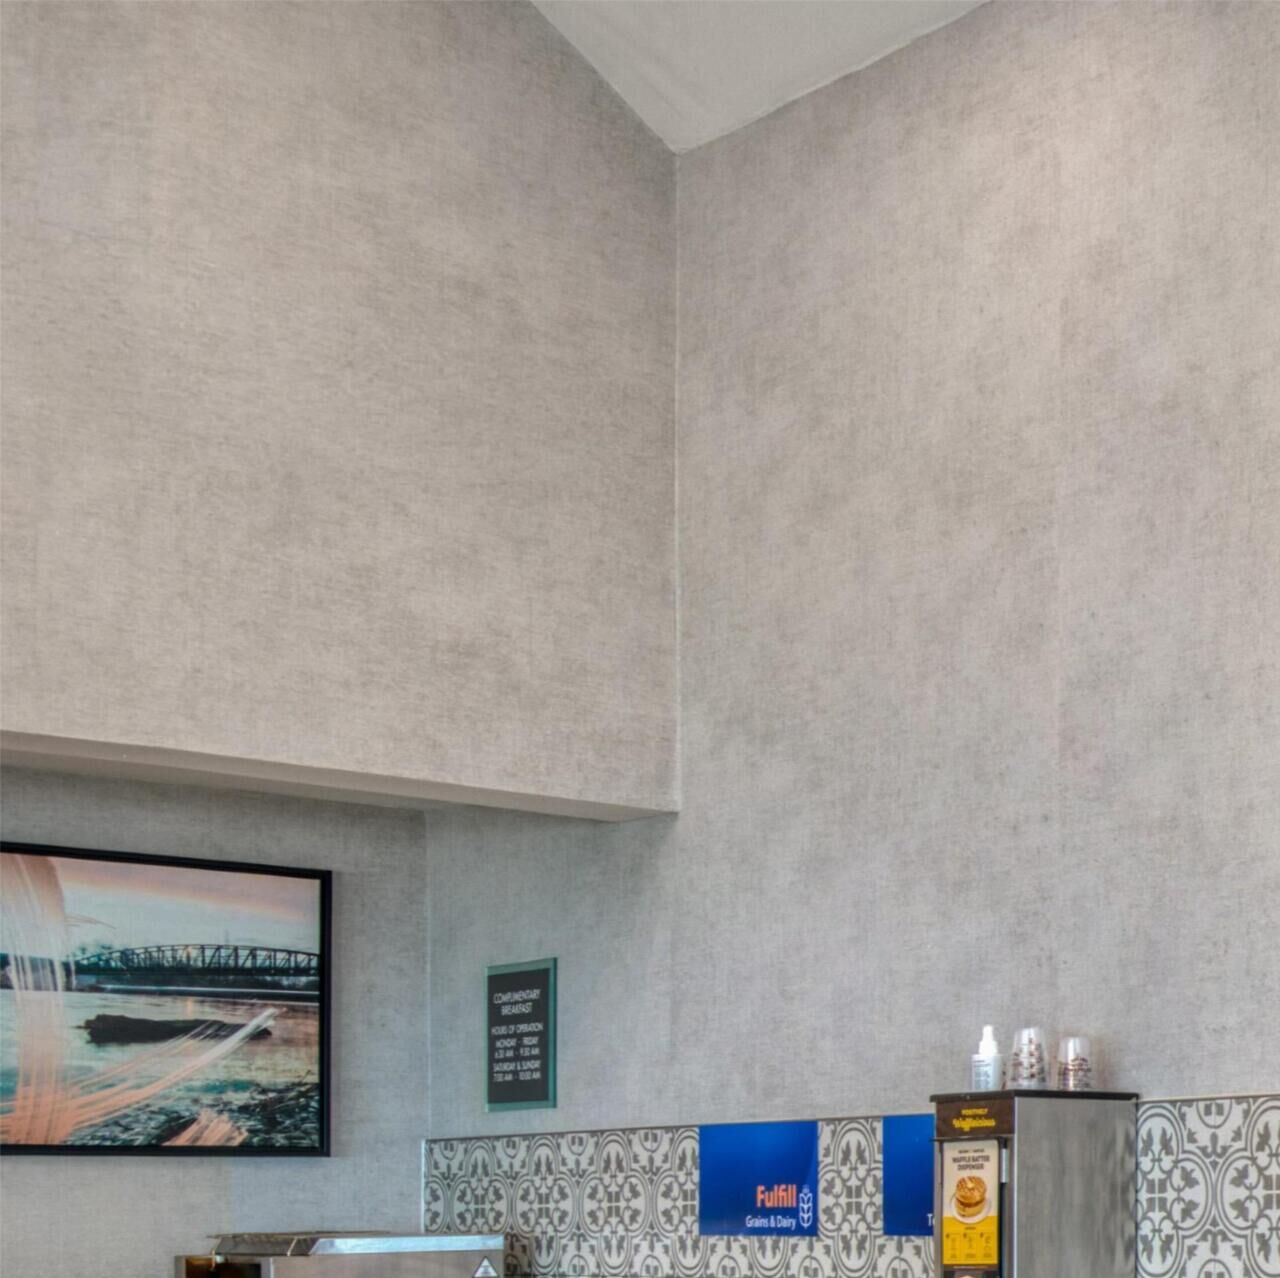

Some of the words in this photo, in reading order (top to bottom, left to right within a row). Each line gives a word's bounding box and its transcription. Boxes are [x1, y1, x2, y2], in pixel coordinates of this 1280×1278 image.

[501, 1002, 533, 1016] BREAKFAST
[496, 1038, 517, 1048] MONDAY
[493, 1062, 515, 1072] SATURDAY
[756, 1184, 797, 1208] Fulfill
[745, 1215, 769, 1228] Grains
[769, 1216, 775, 1227] &
[776, 1215, 796, 1230] Dairy
